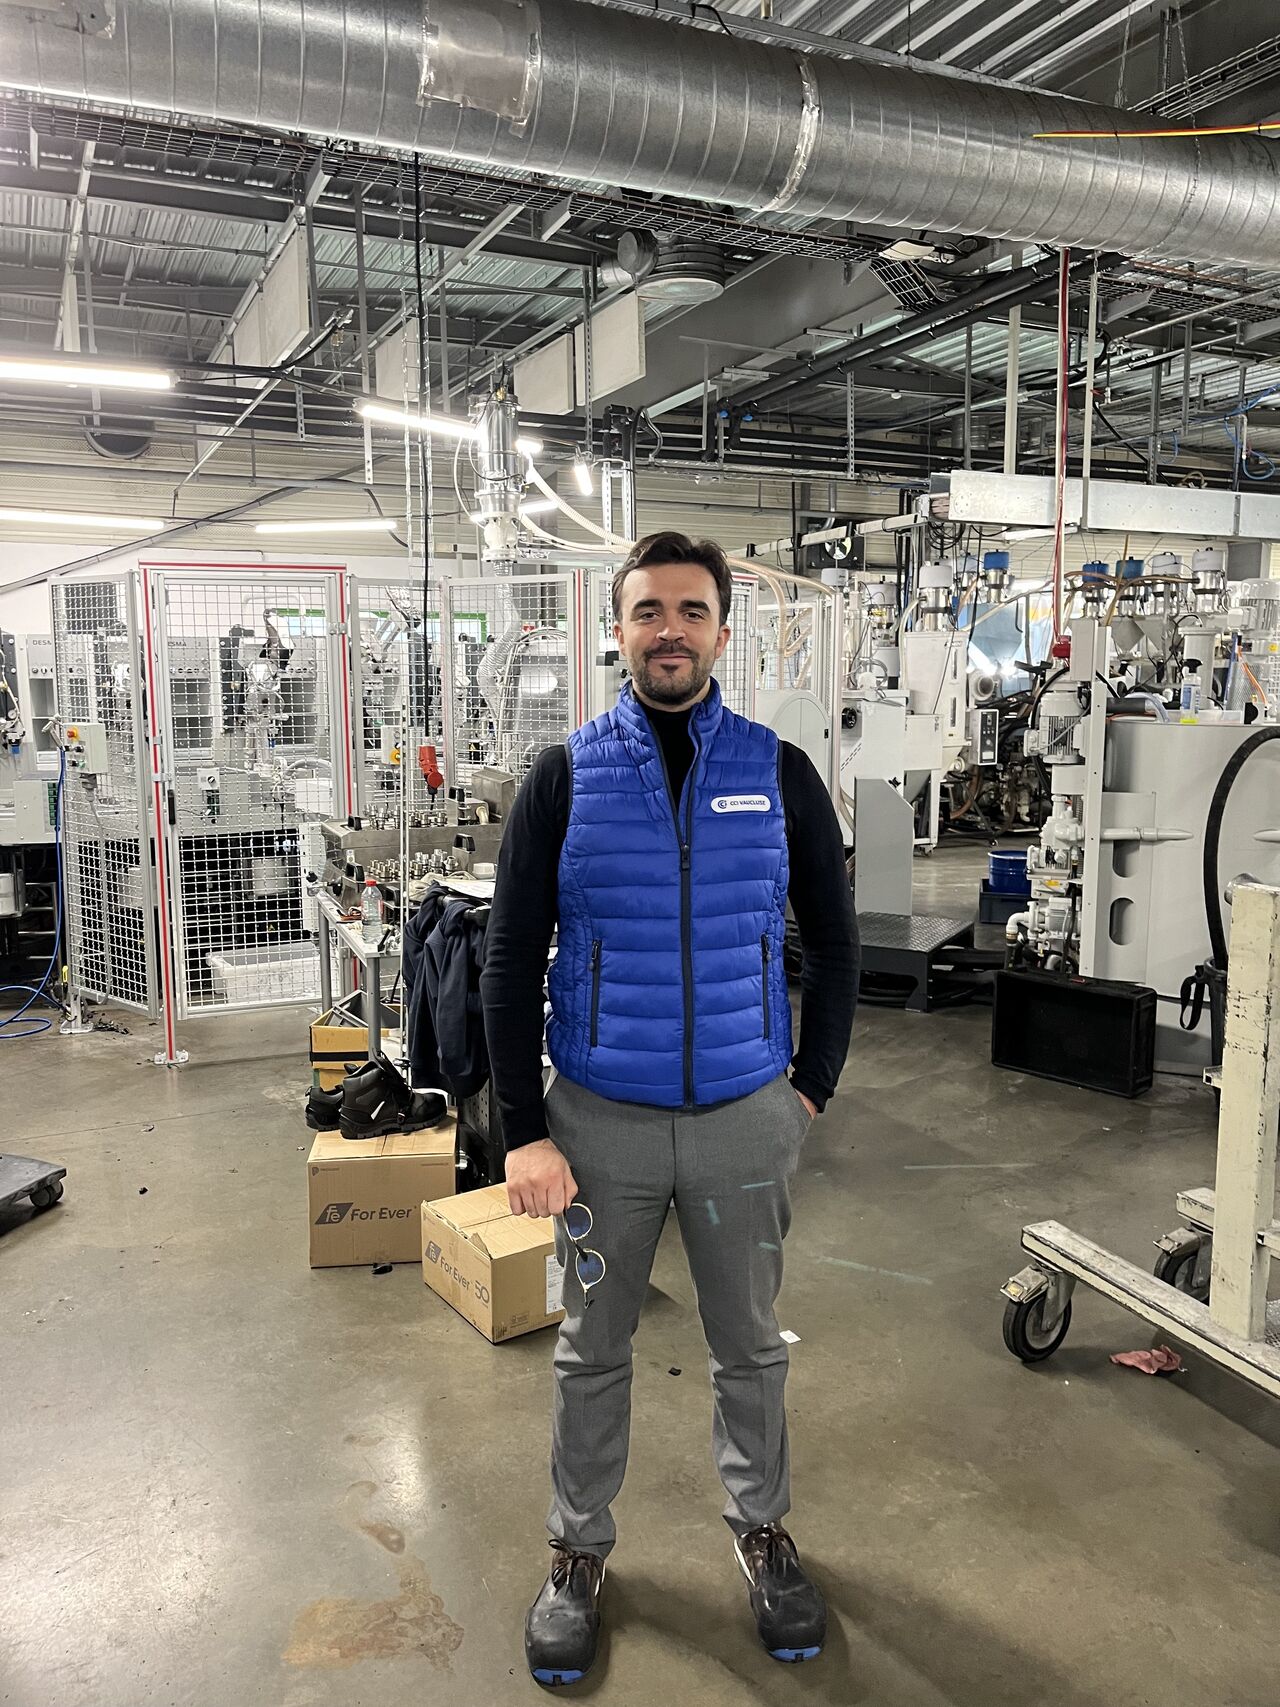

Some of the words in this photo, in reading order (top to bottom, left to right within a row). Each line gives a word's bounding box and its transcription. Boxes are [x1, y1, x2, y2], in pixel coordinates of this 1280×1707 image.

[350, 1208, 376, 1221] For
[378, 1207, 413, 1220] Ever
[440, 1256, 453, 1275] For
[453, 1267, 471, 1291] Ever
[474, 1280, 490, 1304] 50
